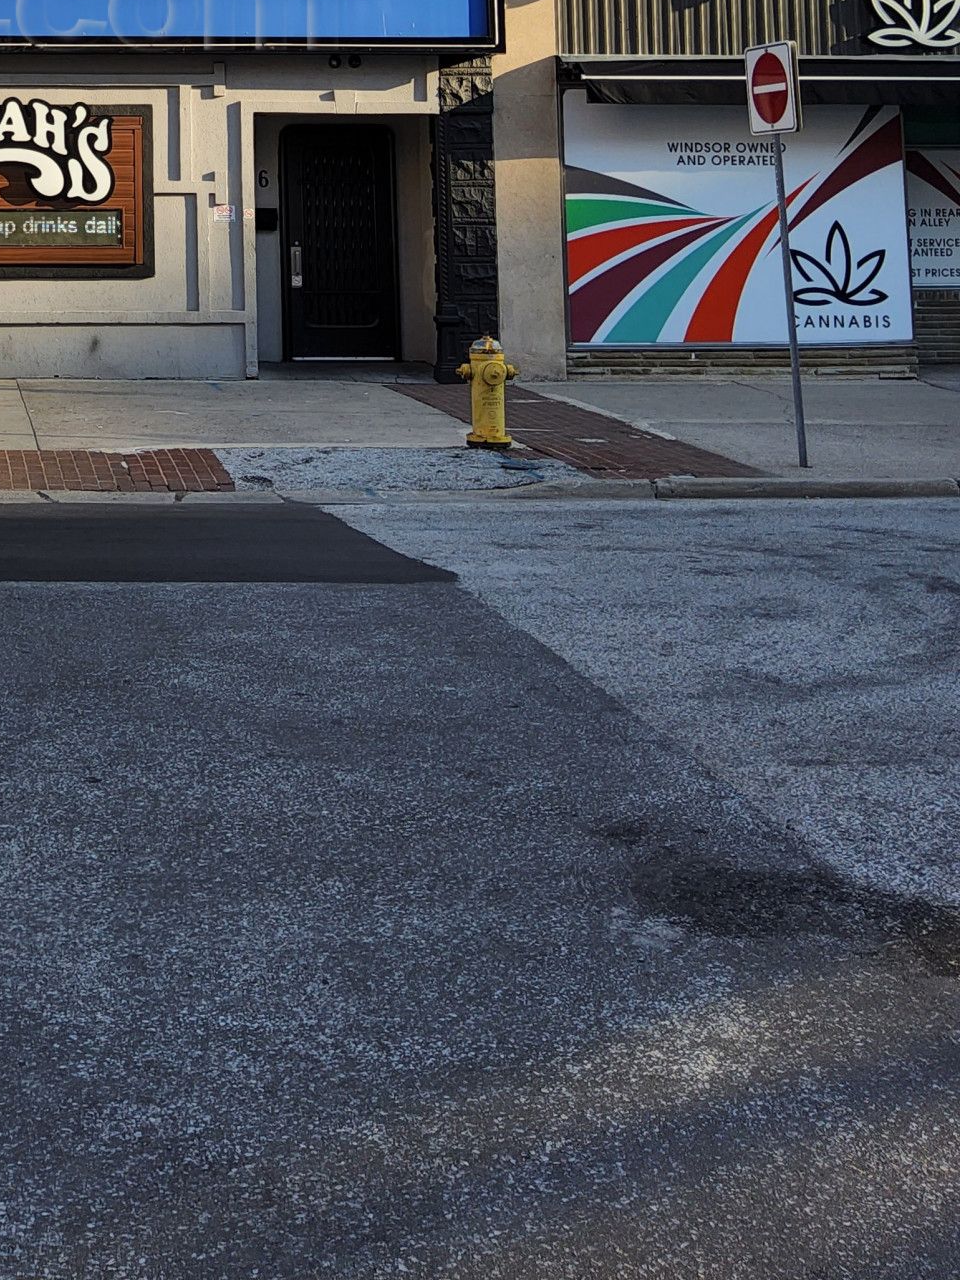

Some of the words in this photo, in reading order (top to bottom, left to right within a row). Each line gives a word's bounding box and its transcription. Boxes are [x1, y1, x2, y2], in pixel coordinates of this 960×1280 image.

[667, 142, 731, 153] WINDSOR
[676, 155, 706, 166] AND
[920, 209, 931, 217] IN
[22, 216, 78, 234] drinks
[920, 218, 950, 227] ALLEY
[917, 238, 960, 248] SERVICE
